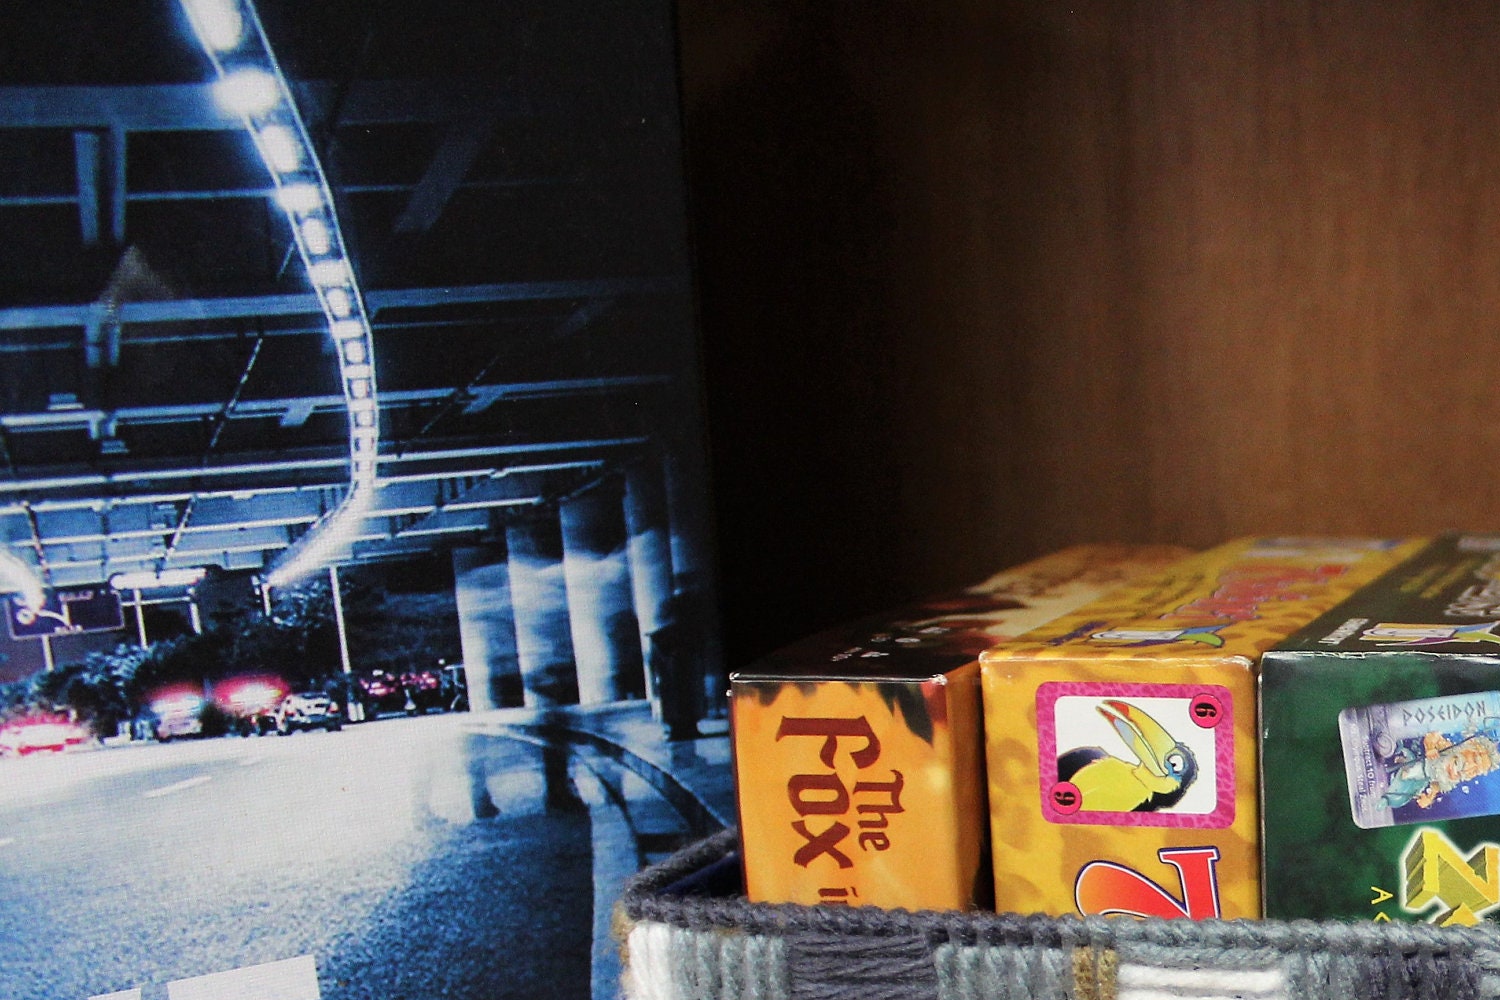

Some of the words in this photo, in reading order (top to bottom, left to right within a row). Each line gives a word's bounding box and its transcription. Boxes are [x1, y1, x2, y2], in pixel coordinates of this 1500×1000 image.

[1403, 701, 1487, 726] POSEIDON
[776, 715, 882, 869] Fox
[853, 769, 906, 852] The
[818, 886, 859, 905] i
